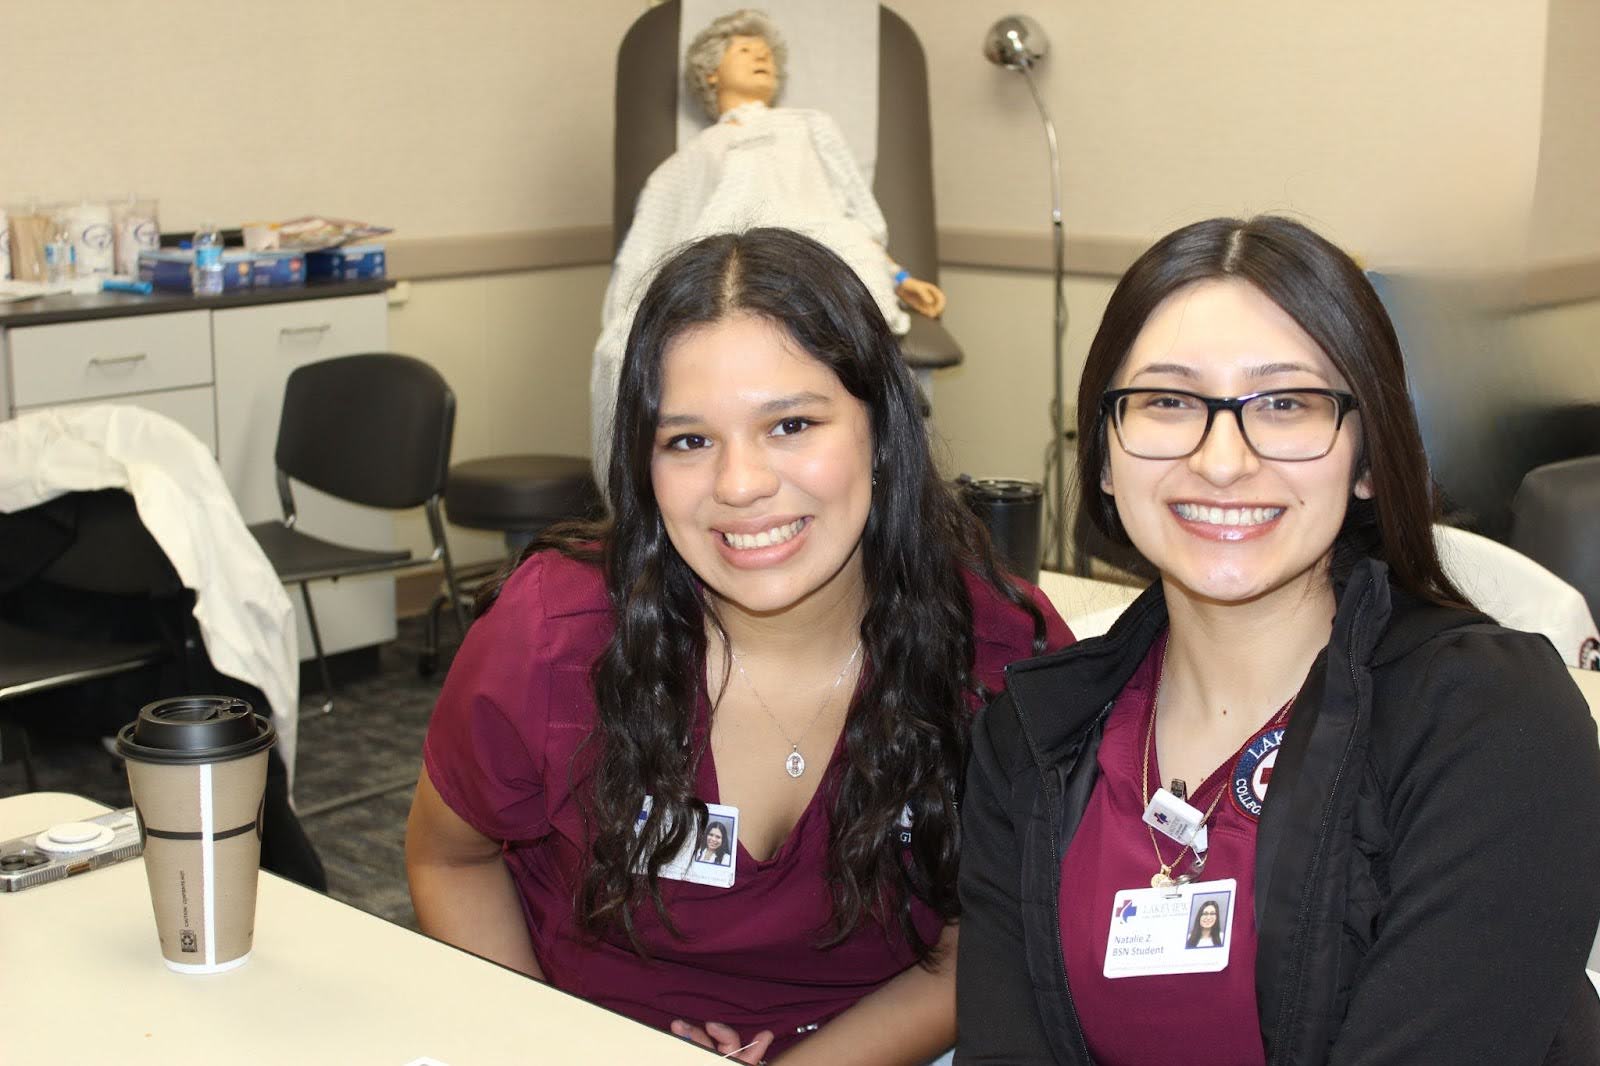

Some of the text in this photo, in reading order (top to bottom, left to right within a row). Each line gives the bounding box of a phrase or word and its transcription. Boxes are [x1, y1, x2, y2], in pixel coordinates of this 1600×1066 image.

[1248, 730, 1285, 759] LAK
[1236, 778, 1262, 815] COLLEG
[1114, 933, 1145, 944] Natalie
[1112, 945, 1165, 957] BSN Student
